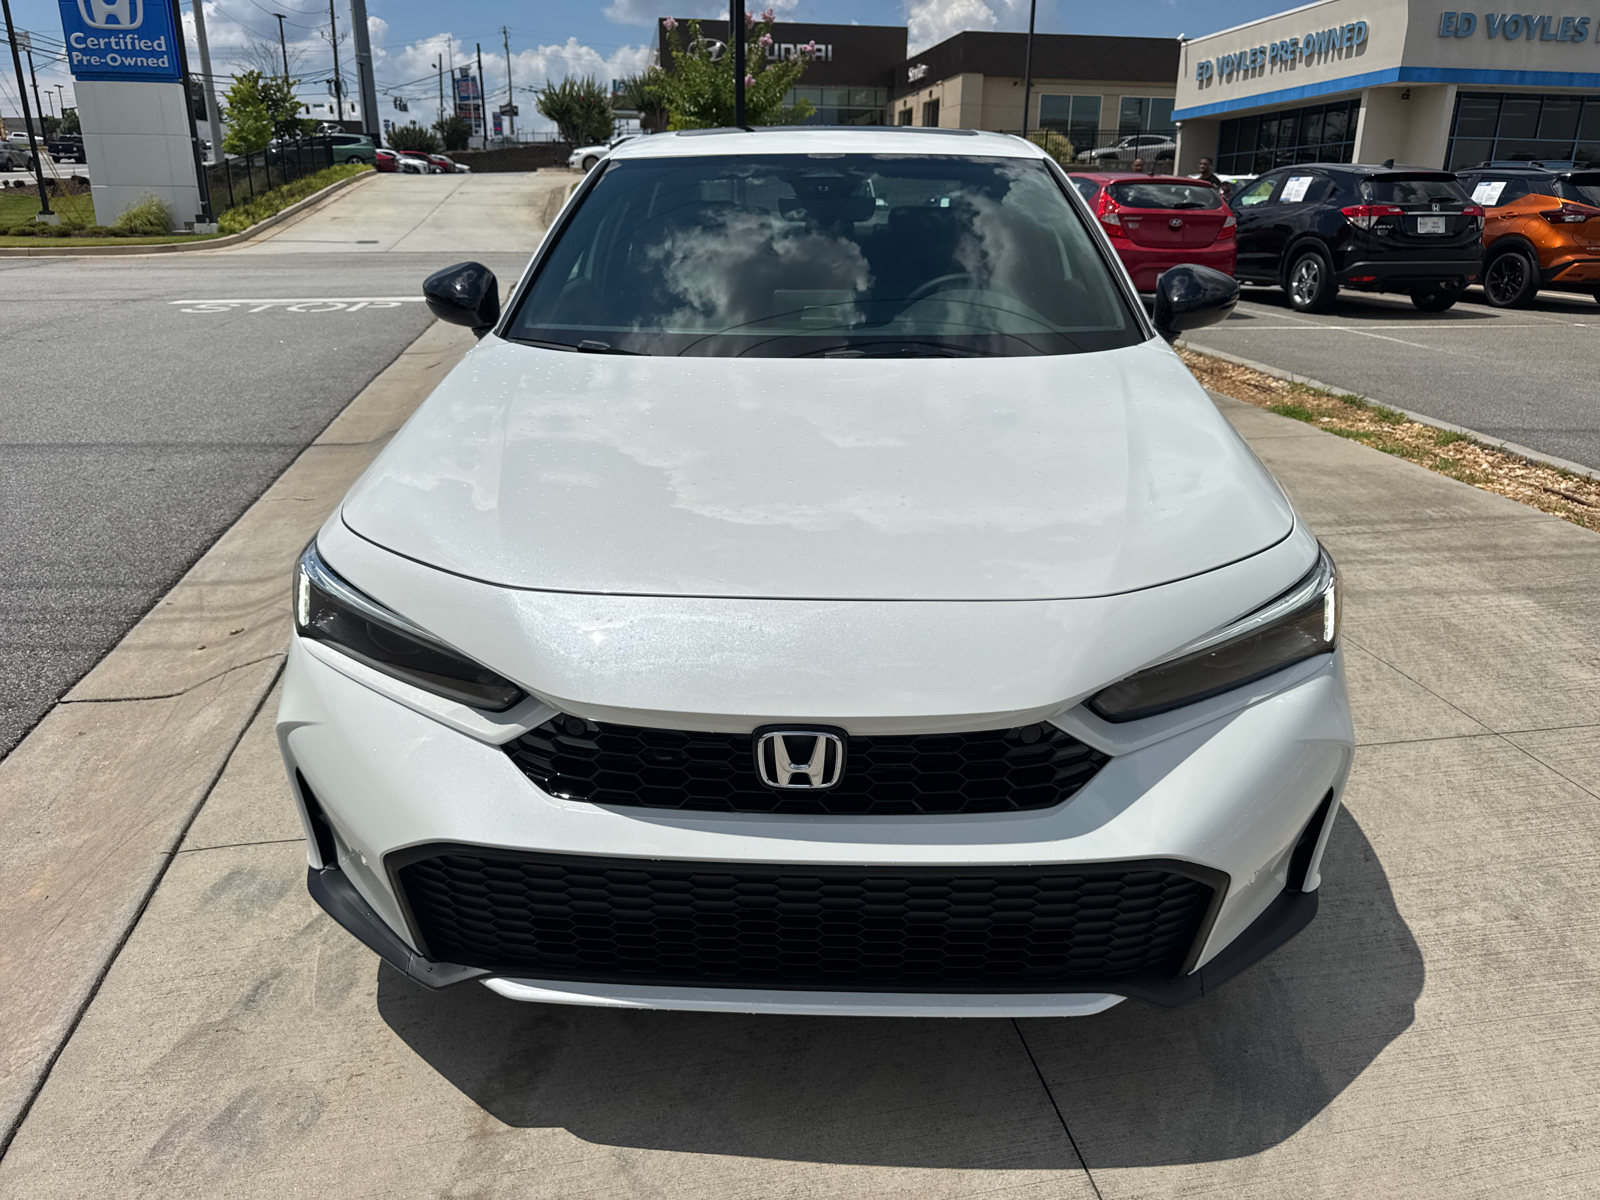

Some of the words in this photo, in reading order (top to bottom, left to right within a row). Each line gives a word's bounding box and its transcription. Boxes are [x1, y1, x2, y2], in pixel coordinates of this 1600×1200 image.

[1438, 11, 1478, 38] ED
[1486, 13, 1591, 43] VOYLES
[69, 32, 167, 52] Certified
[1195, 60, 1213, 81] ED
[1216, 45, 1266, 76] VOYLES
[1268, 20, 1368, 65] PRE-OWNED
[71, 51, 169, 68] Pre-Owned
[180, 302, 403, 314] STOP
